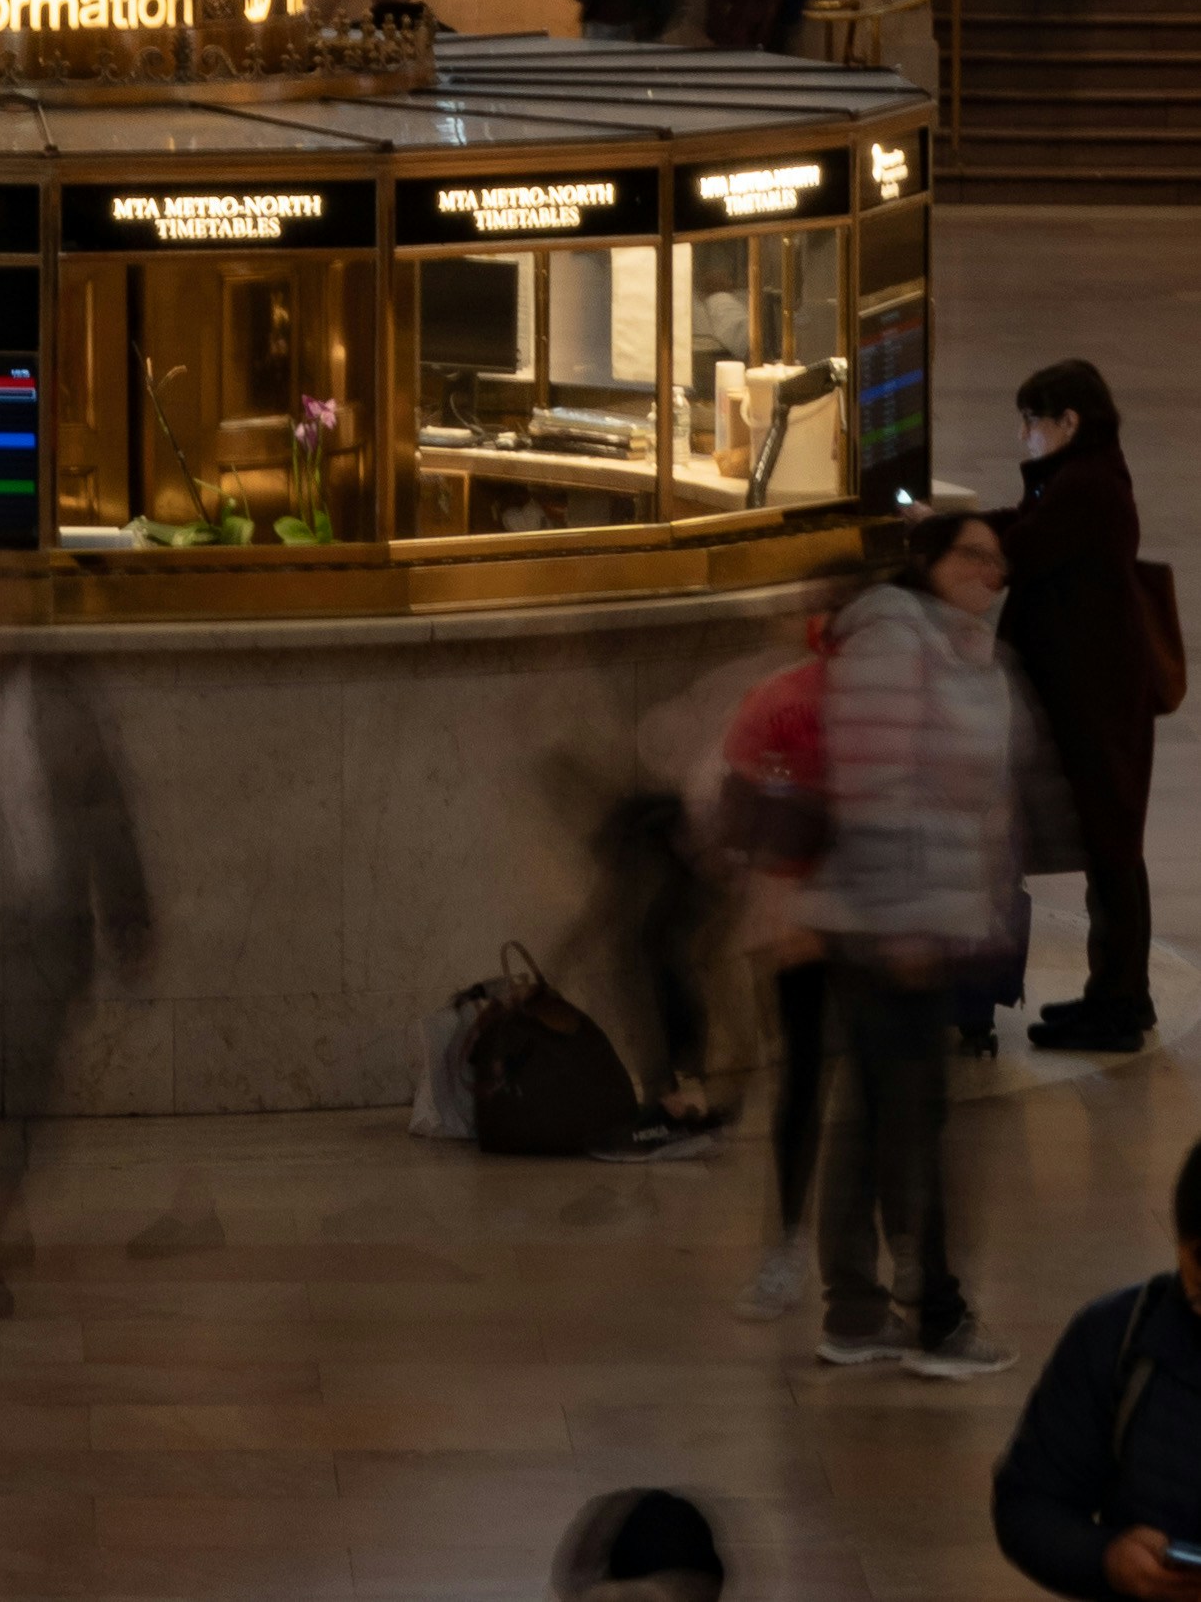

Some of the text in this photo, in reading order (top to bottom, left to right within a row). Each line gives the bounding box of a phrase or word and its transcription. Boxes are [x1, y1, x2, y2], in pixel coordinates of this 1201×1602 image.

[113, 195, 322, 219] MTA METRO-NORTH
[439, 183, 615, 212] MTA METRO-NORTH
[155, 217, 281, 239] TIMETABLES
[473, 206, 580, 231] TIMETABLES
